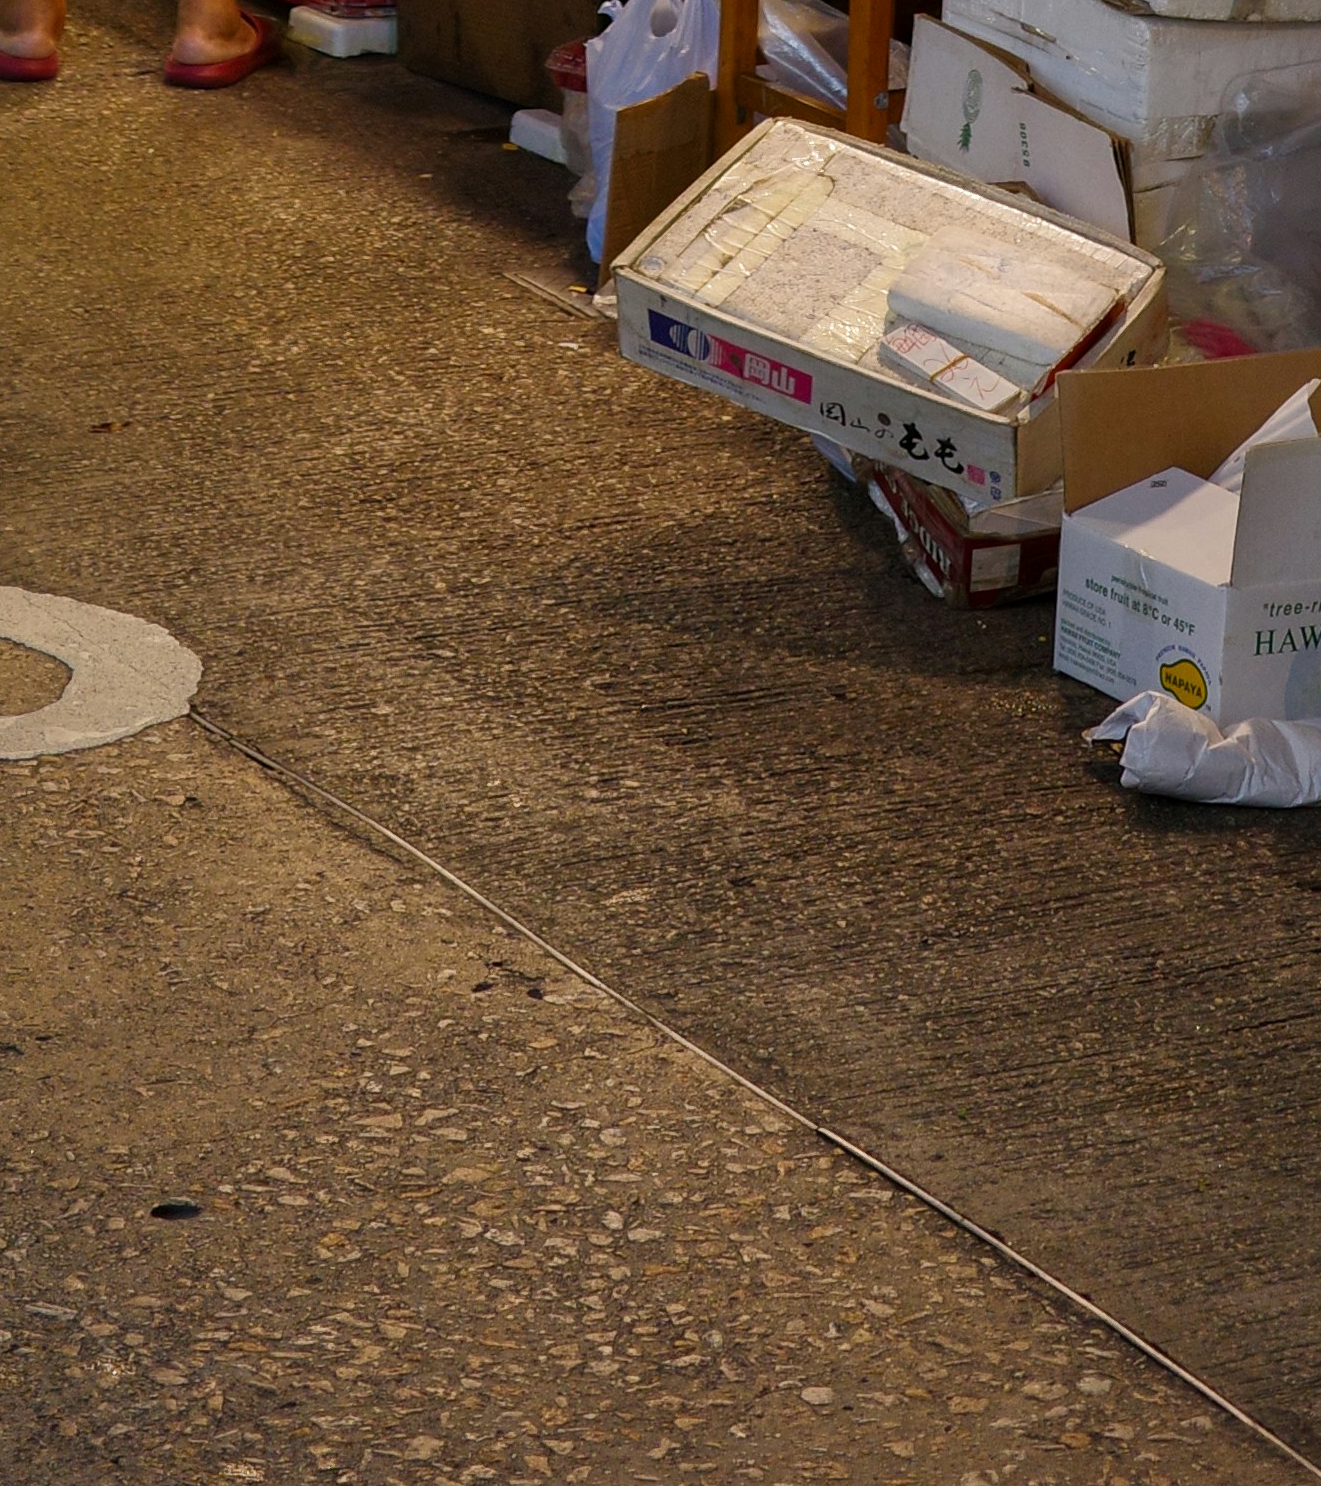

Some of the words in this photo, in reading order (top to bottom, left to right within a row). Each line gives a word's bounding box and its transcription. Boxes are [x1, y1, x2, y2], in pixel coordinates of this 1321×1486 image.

[742, 351, 796, 395] 岡山
[1085, 577, 1109, 598] store
[1110, 589, 1130, 609] fruit
[1131, 599, 1142, 613] at
[1142, 602, 1160, 621] 8°C
[1161, 612, 1172, 627] or
[1173, 618, 1196, 637] 45°F
[1164, 672, 1203, 699] HAPAYA
